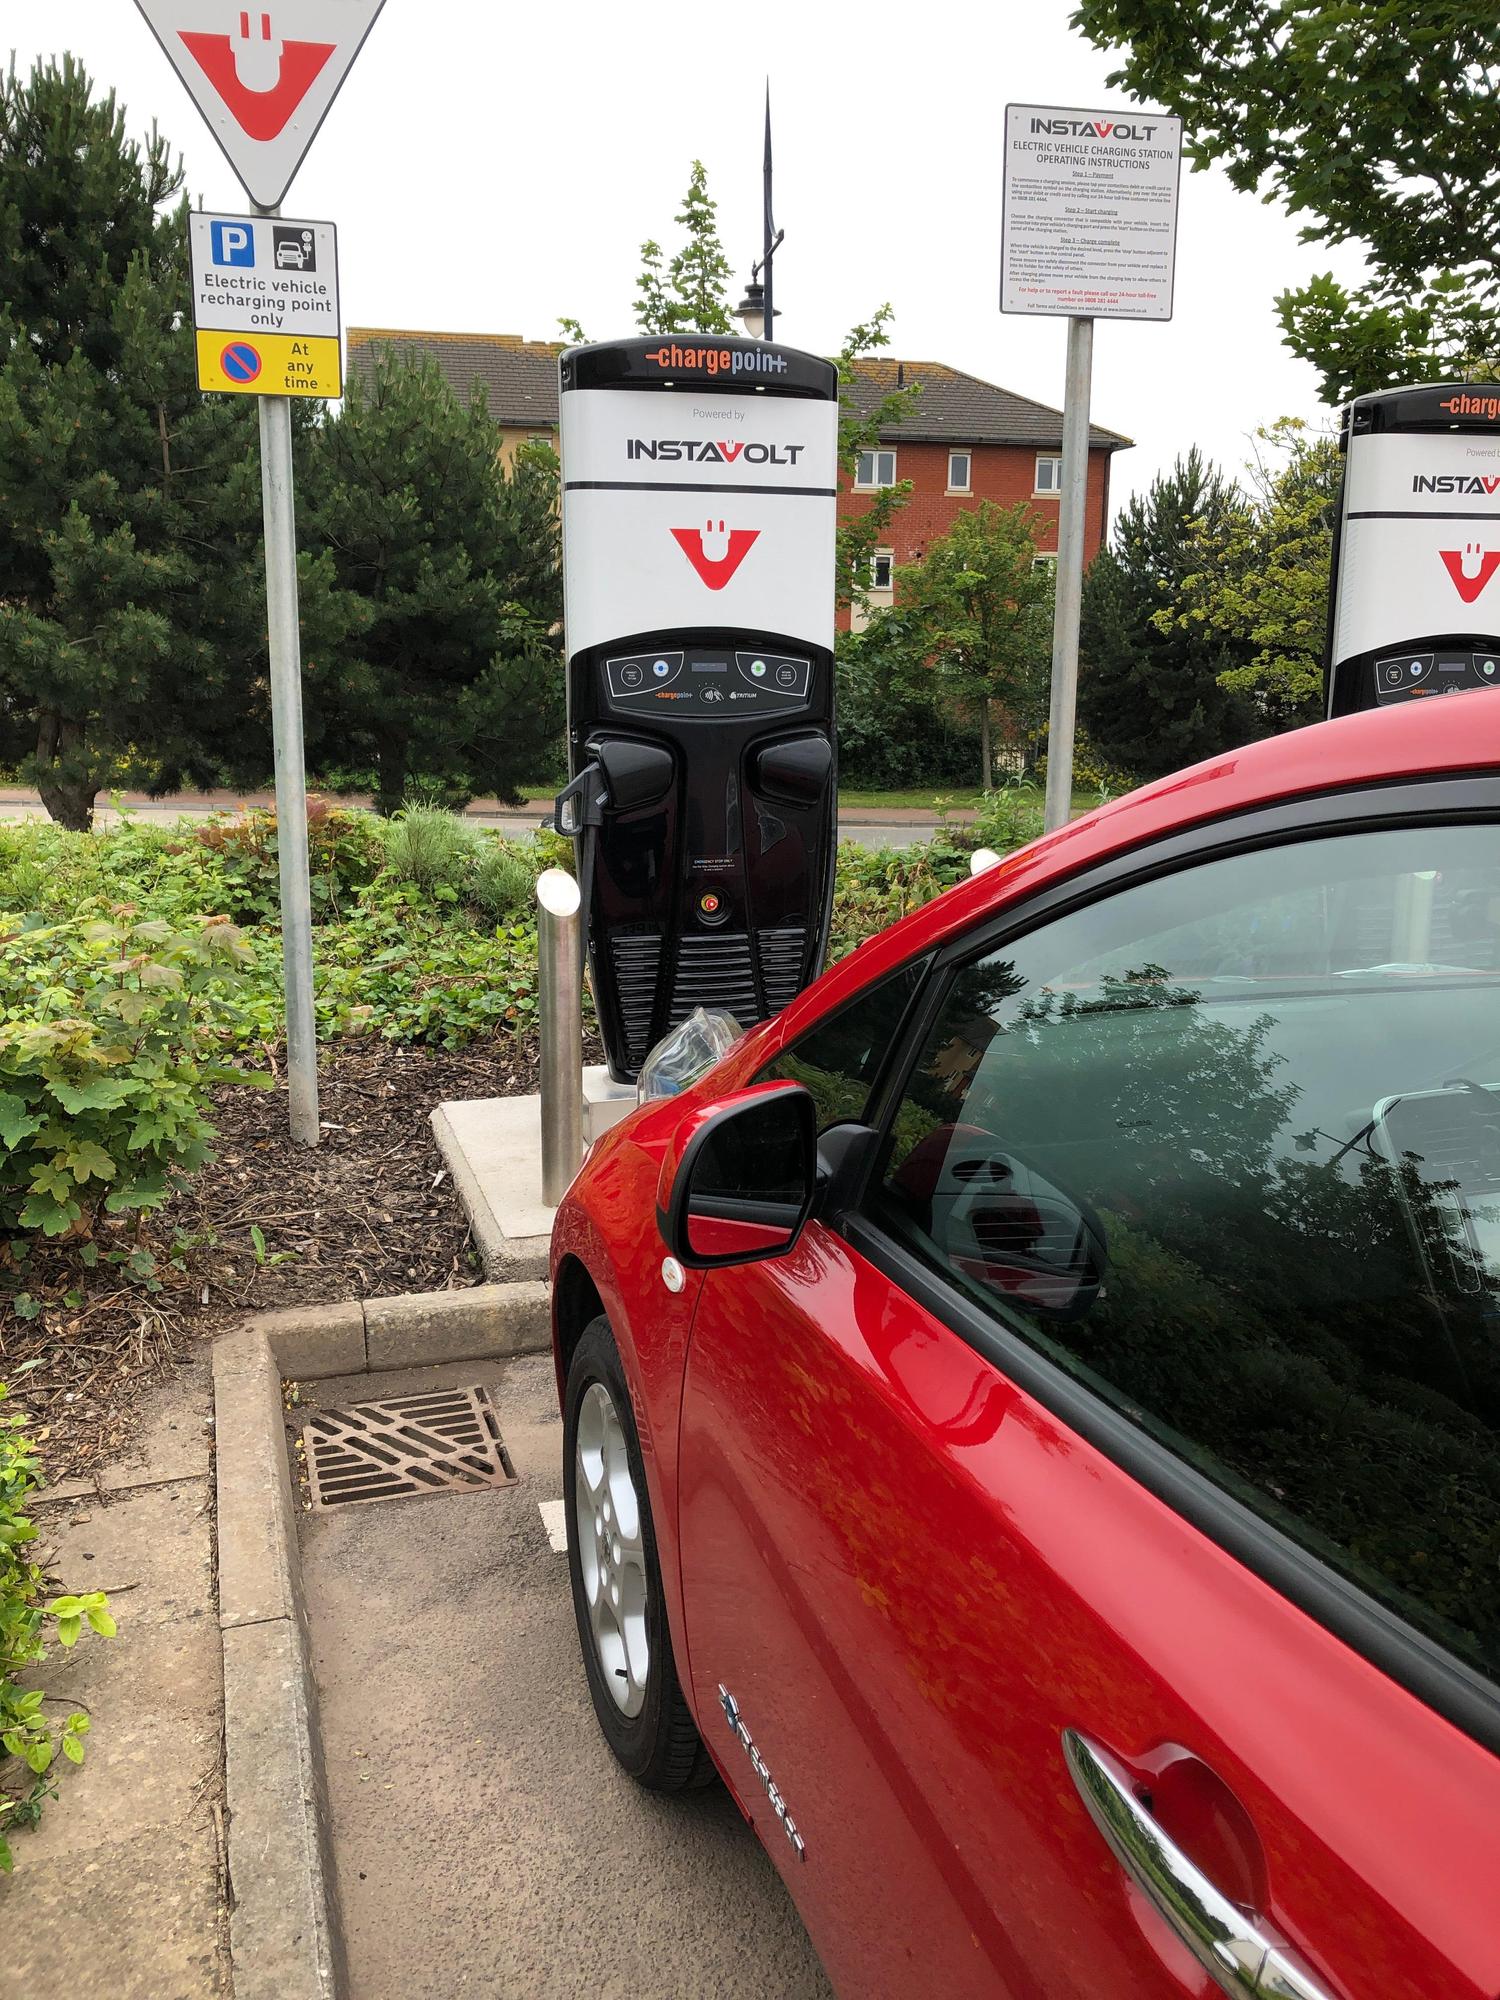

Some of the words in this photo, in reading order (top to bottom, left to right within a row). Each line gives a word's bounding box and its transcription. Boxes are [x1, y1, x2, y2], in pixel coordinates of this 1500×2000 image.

[1031, 118, 1158, 141] INSTAVOLT
[1013, 141, 1052, 152] ELECTRIC
[1054, 144, 1089, 154] VEHICLE
[1091, 146, 1136, 158] CHARGING
[1138, 150, 1173, 160] STATION
[1036, 154, 1086, 166] OPERATING
[1088, 158, 1150, 170] INSTRUCTIONS
[222, 227, 247, 262] P
[204, 274, 266, 291] Electric
[272, 280, 327, 295] vehicle
[200, 293, 286, 311] recharging
[292, 298, 332, 312] point
[251, 313, 283, 328] only
[291, 343, 309, 356] At
[288, 361, 314, 374] any
[284, 376, 318, 389] time
[693, 408, 732, 420] Powered
[734, 410, 745, 422] by
[627, 439, 805, 465] INSTAVOLT
[1466, 448, 1496, 457] Powered
